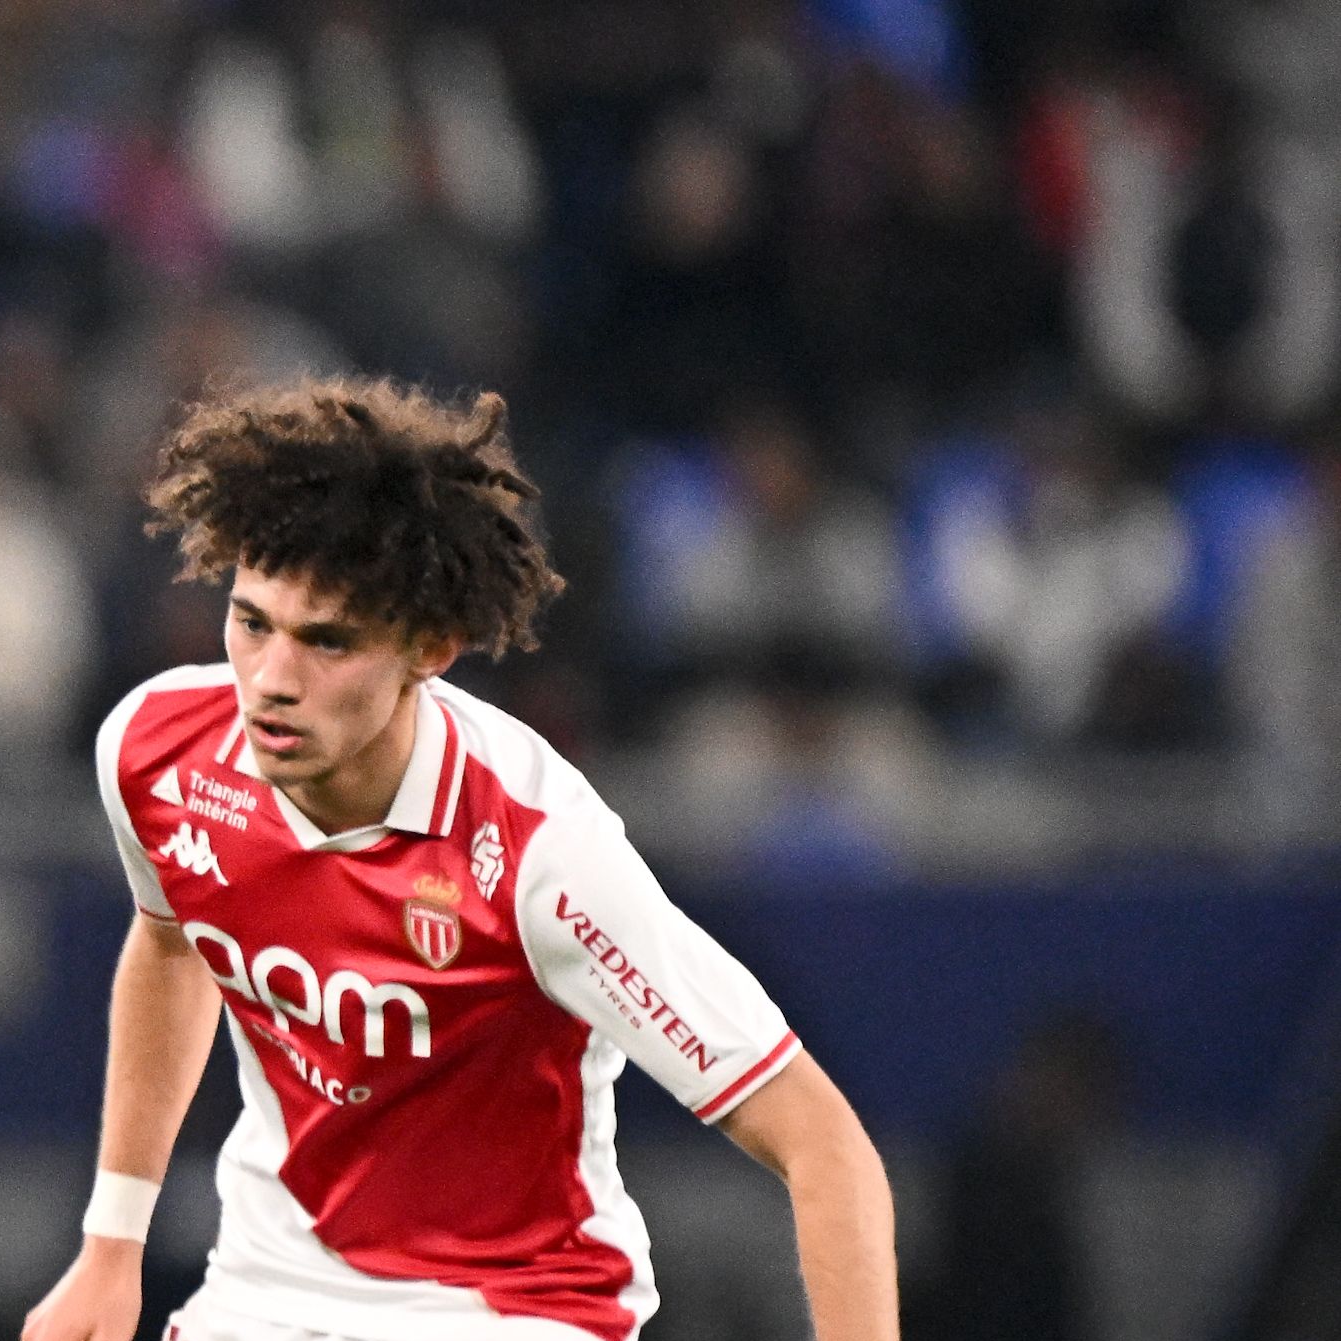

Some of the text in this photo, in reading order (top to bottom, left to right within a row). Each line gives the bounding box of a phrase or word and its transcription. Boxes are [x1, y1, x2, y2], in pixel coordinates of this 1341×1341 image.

[190, 770, 257, 812] Triangle
[555, 892, 718, 1073] VREDESTEIN
[589, 966, 644, 1029] TYRES
